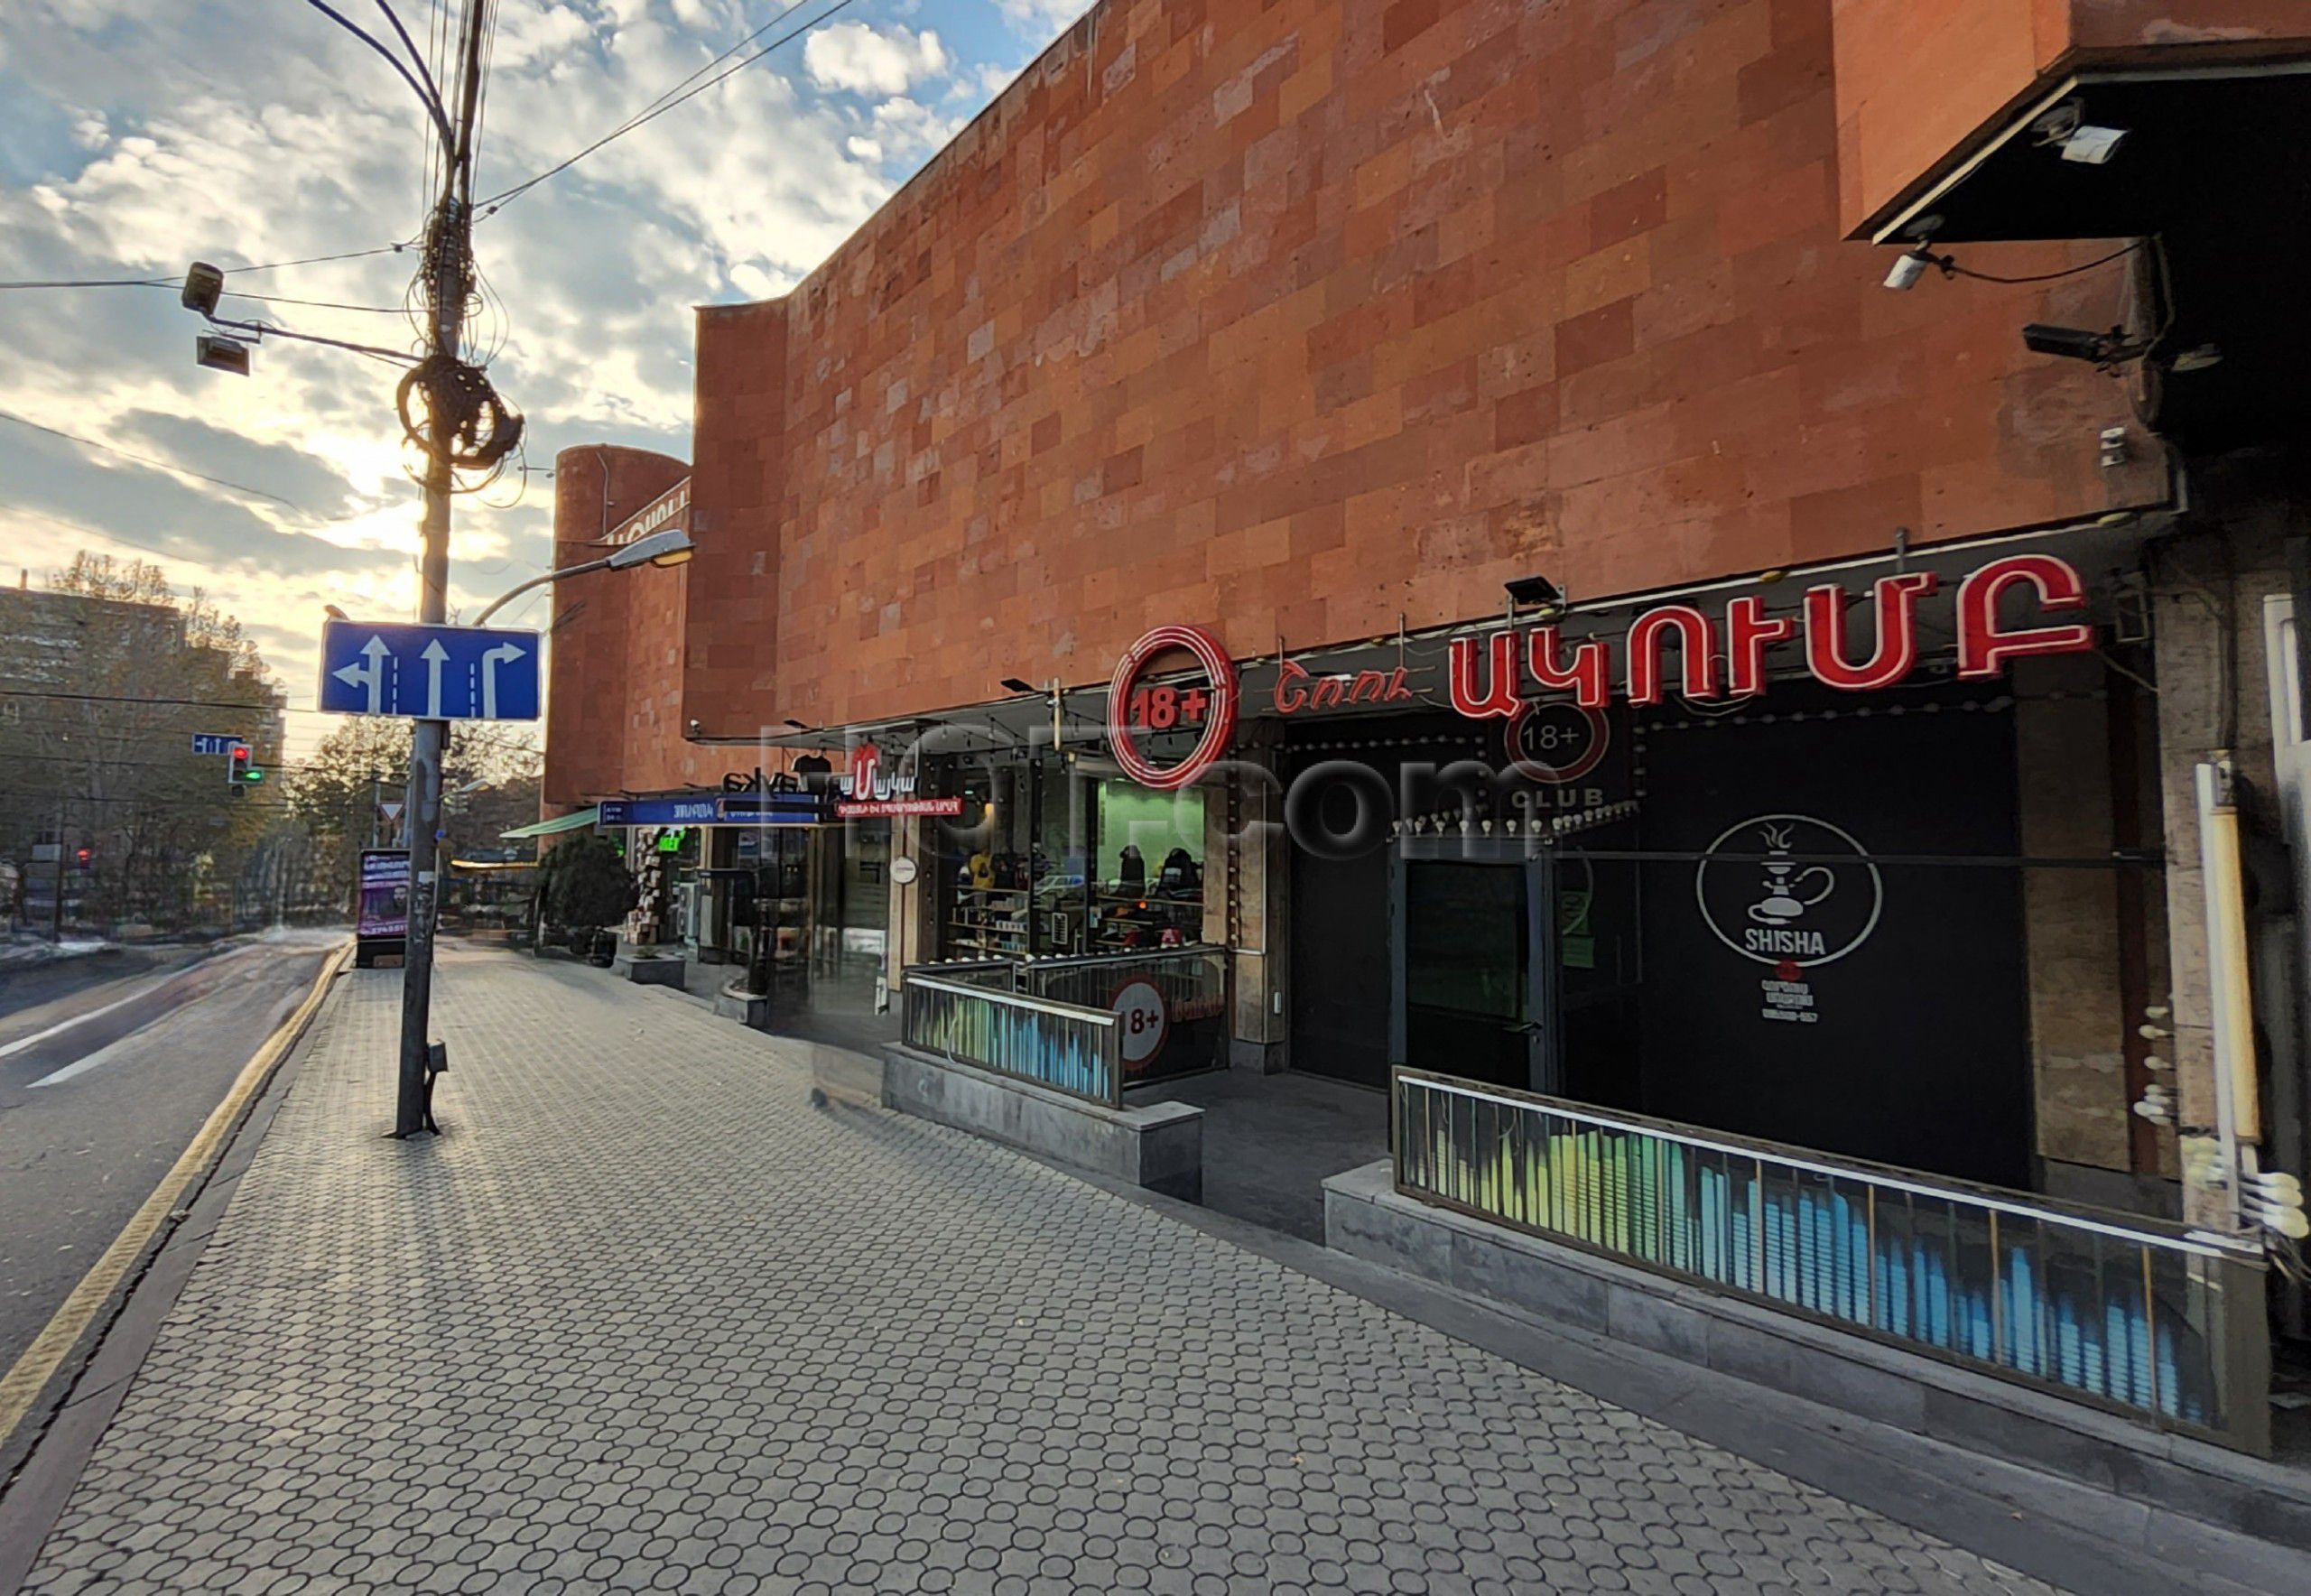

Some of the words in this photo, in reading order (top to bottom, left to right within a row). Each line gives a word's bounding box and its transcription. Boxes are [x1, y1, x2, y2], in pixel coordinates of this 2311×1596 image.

[1274, 658, 1414, 714] Շոու
[1449, 553, 2093, 720] ԱԿՈՒՄԲ
[1131, 685, 1207, 729] 18+
[1523, 724, 1581, 752] 18+
[1510, 788, 1604, 809] CLUB
[1744, 928, 1826, 955] SHISHA
[1130, 1007, 1159, 1035] 8+
